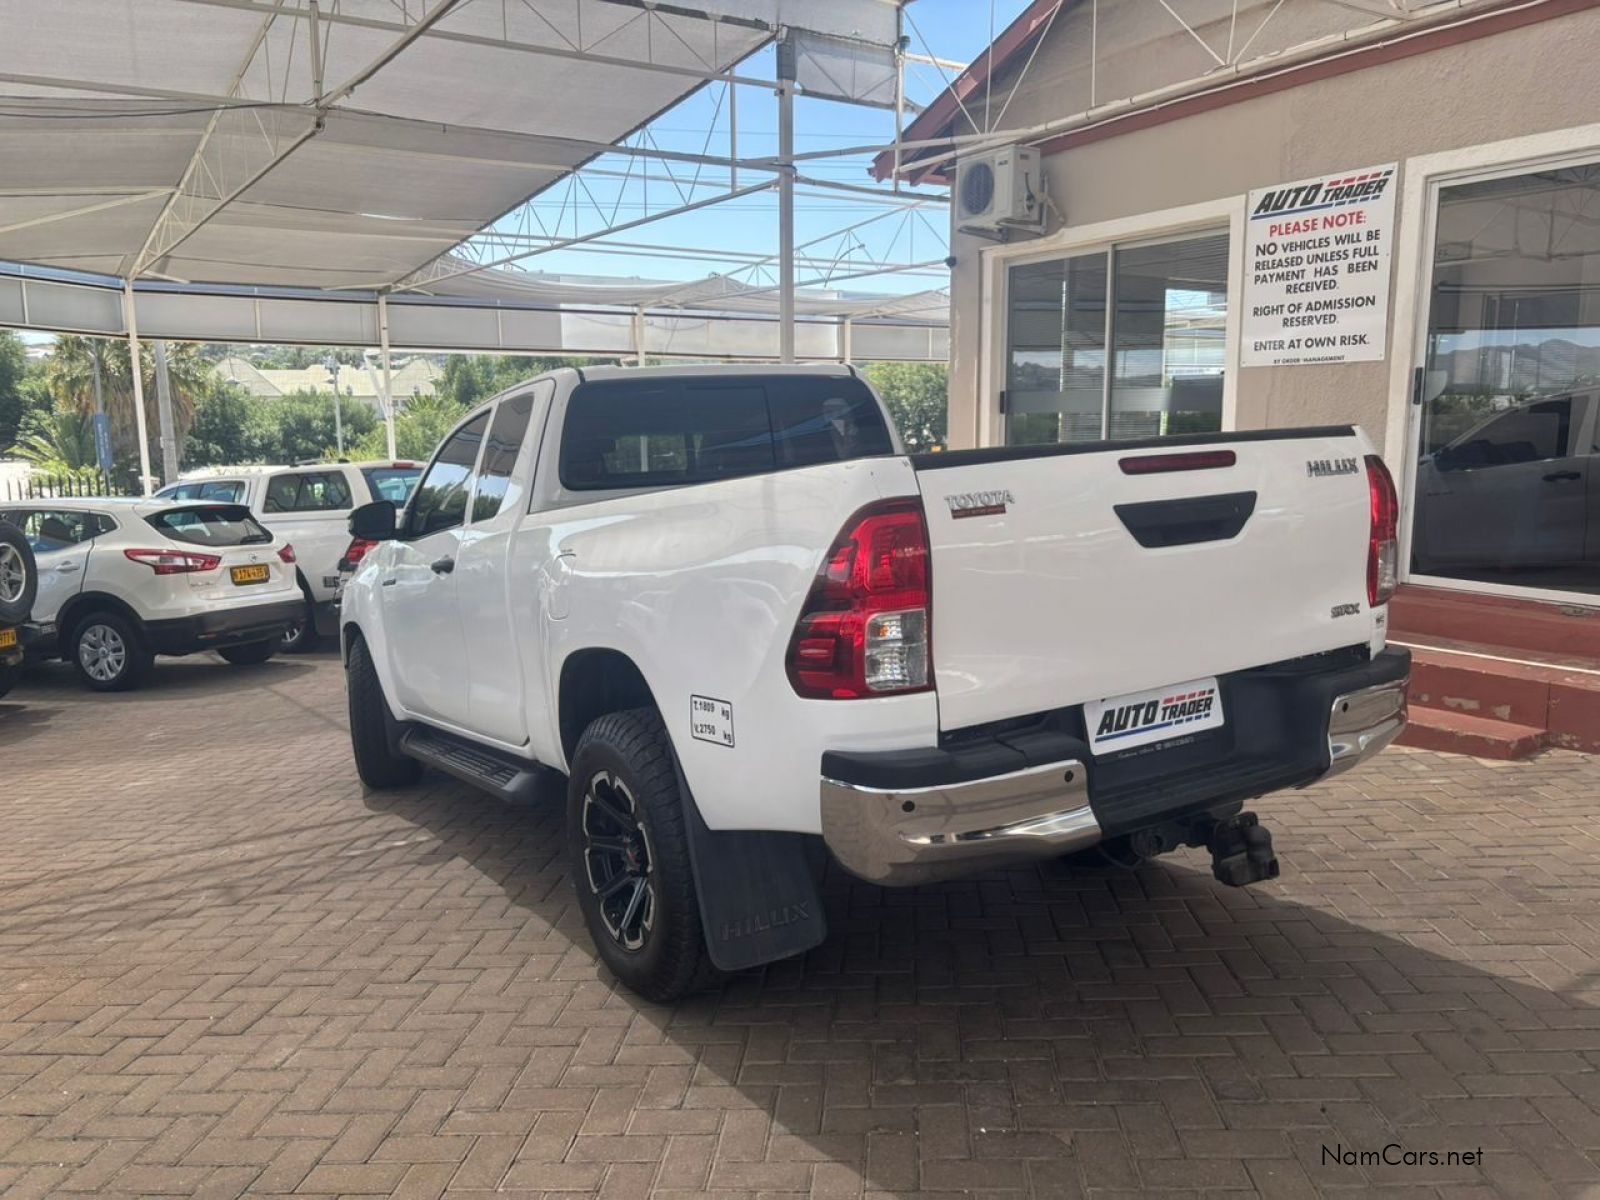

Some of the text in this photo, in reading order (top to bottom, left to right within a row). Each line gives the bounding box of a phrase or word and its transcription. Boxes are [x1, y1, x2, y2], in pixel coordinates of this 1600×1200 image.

[1253, 178, 1389, 215] AUTO TRADER
[1269, 211, 1367, 237] PLEASE NOTE:
[1255, 229, 1381, 257] NO VEHICLES WILL BE
[1254, 245, 1380, 272] RELEASED UNLESS FULL
[1254, 260, 1378, 285] PAYMENT HAS BEEN
[1285, 279, 1340, 295] RECEIVED.
[1253, 295, 1376, 317] RIGHT OF ADMISSION
[1282, 313, 1340, 328] RESERVED.
[1253, 334, 1370, 352] ENTER AT OWN RISK.
[1303, 355, 1345, 363] MANAGEMENT
[1306, 458, 1359, 478] HILUX
[943, 489, 1015, 509] TOYOTA
[721, 706, 730, 721] kg
[1096, 697, 1214, 736] AUTO TRADER
[723, 730, 732, 745] kg
[720, 898, 809, 942] HILUX
